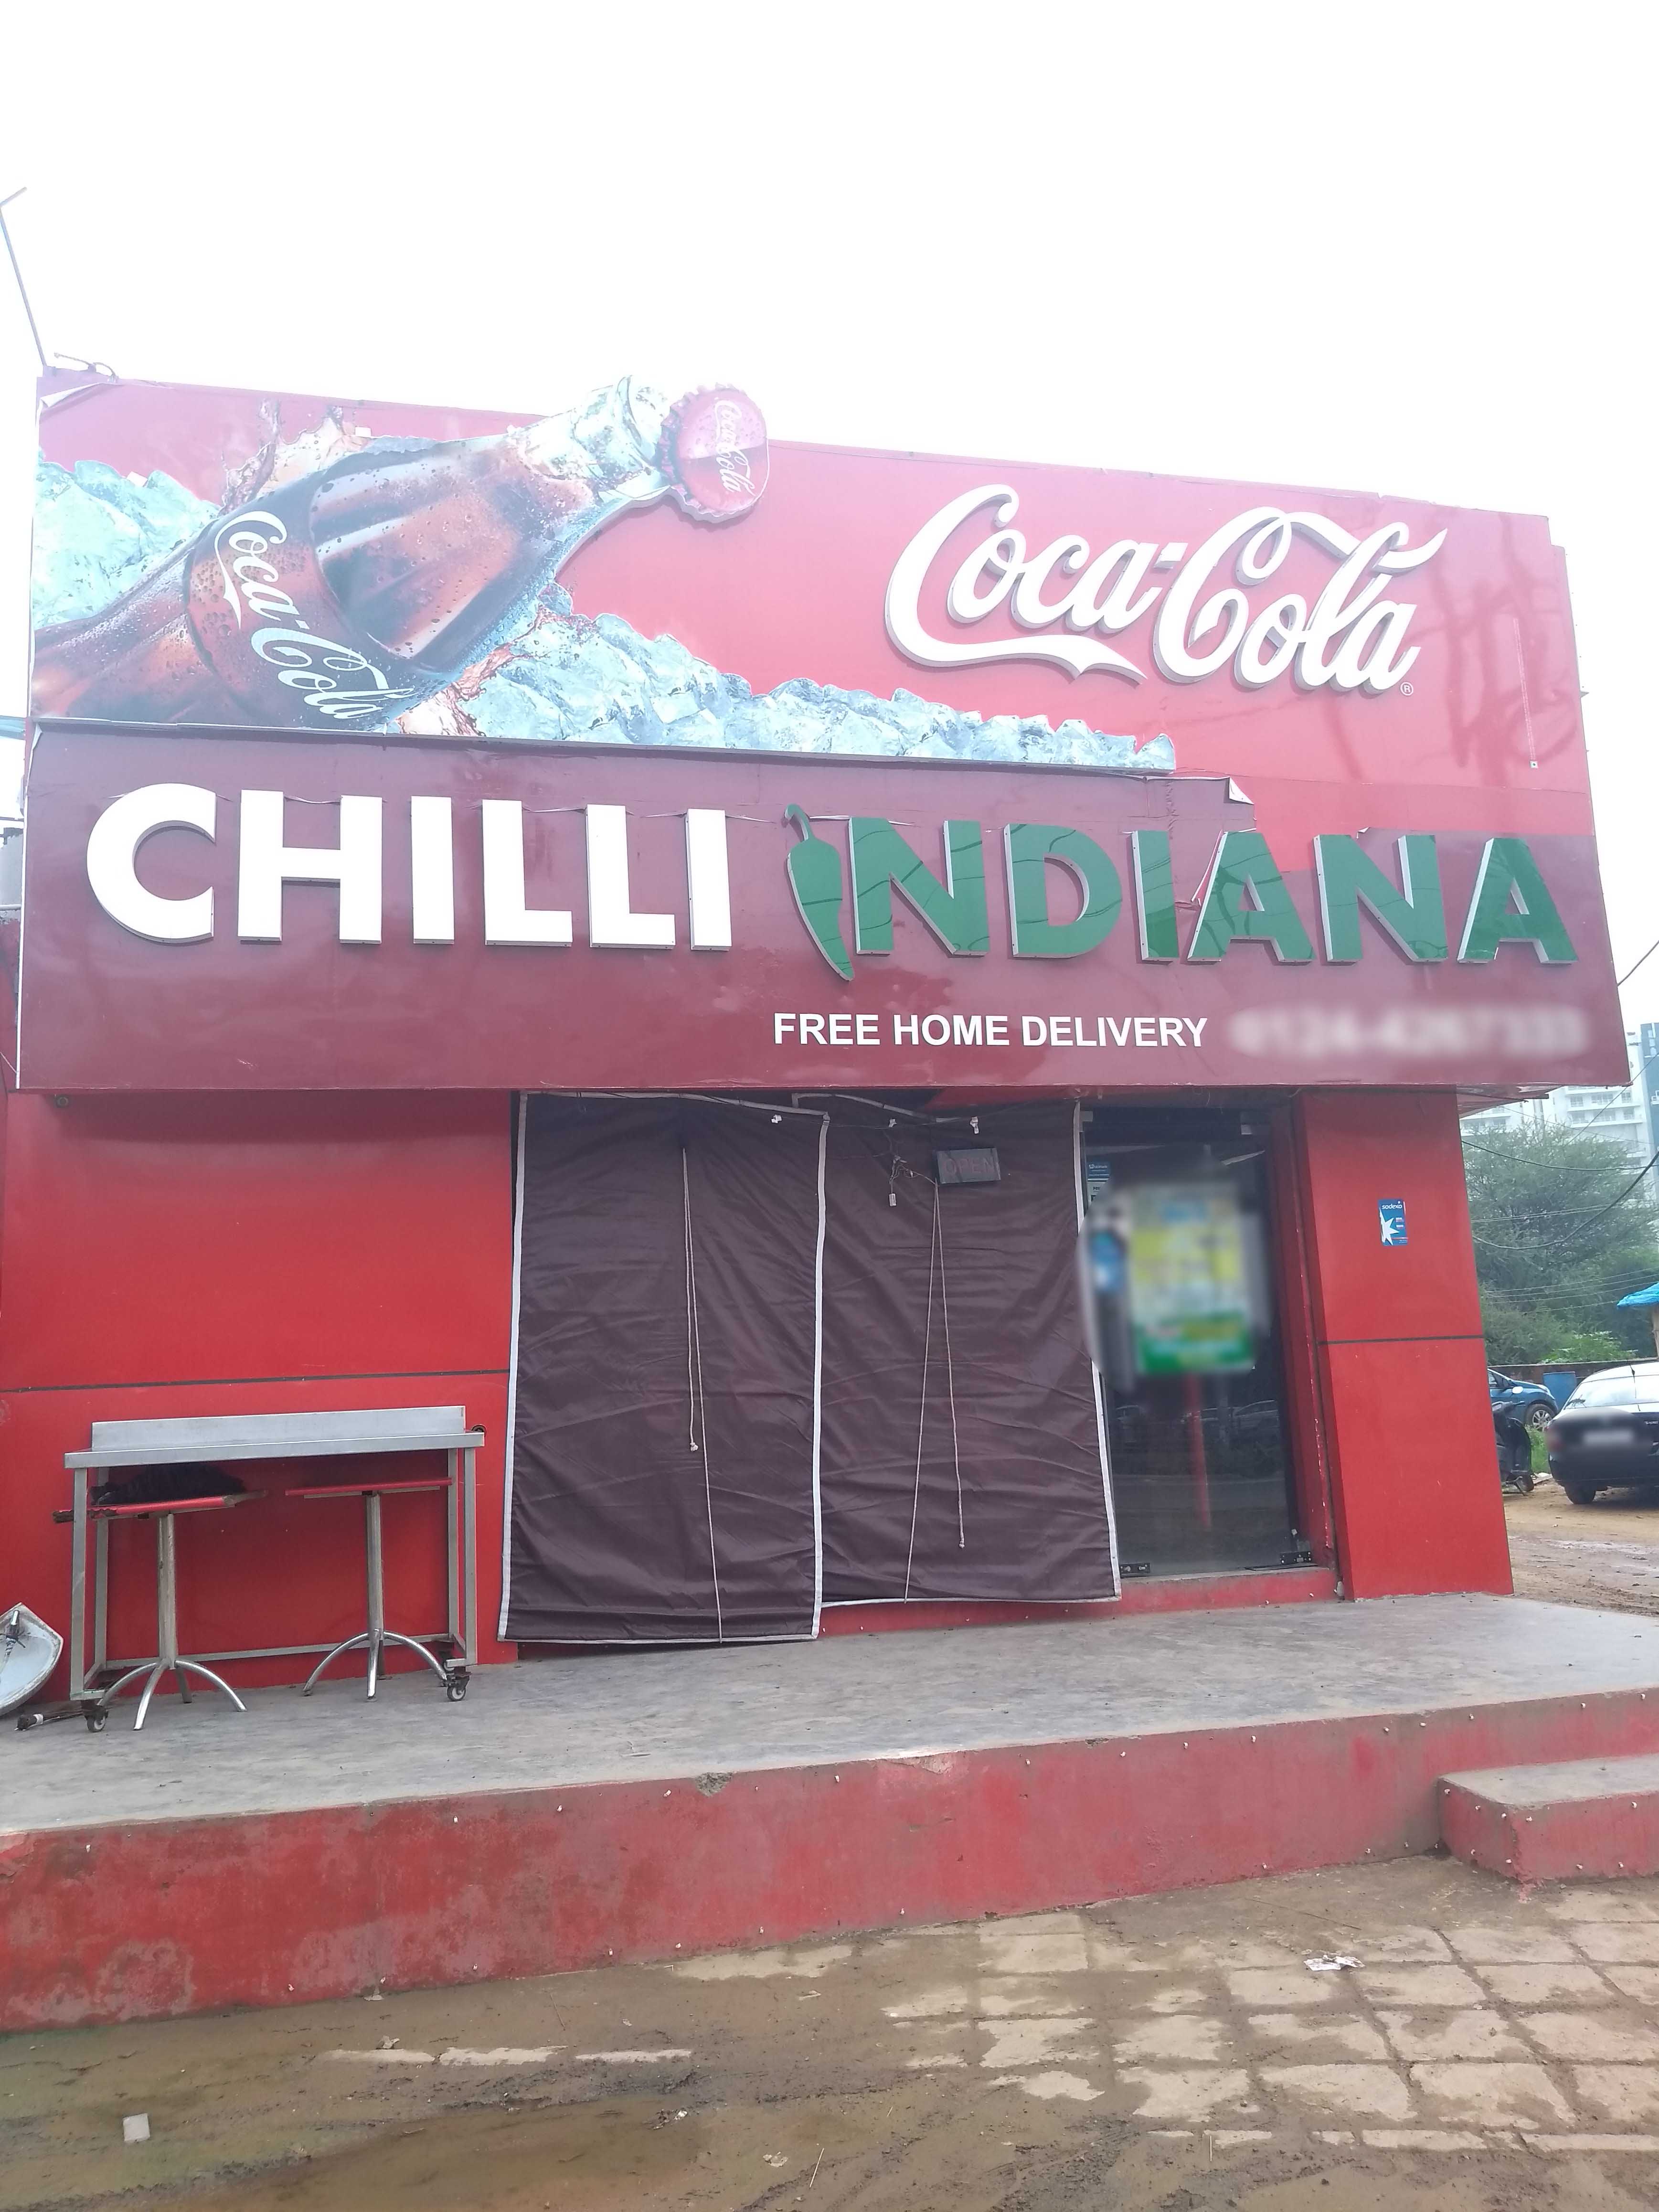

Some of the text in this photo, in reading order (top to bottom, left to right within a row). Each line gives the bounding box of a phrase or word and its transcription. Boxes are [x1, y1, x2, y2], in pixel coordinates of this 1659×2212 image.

[214, 511, 418, 719] Coca-Cola
[885, 484, 1447, 694] Coca-Cola
[87, 783, 733, 951] CHILLI
[774, 1012, 880, 1045] FREE
[894, 1014, 1010, 1046] HOME
[1022, 1016, 1208, 1047] DELIVERY
[943, 1156, 995, 1175] OPEN
